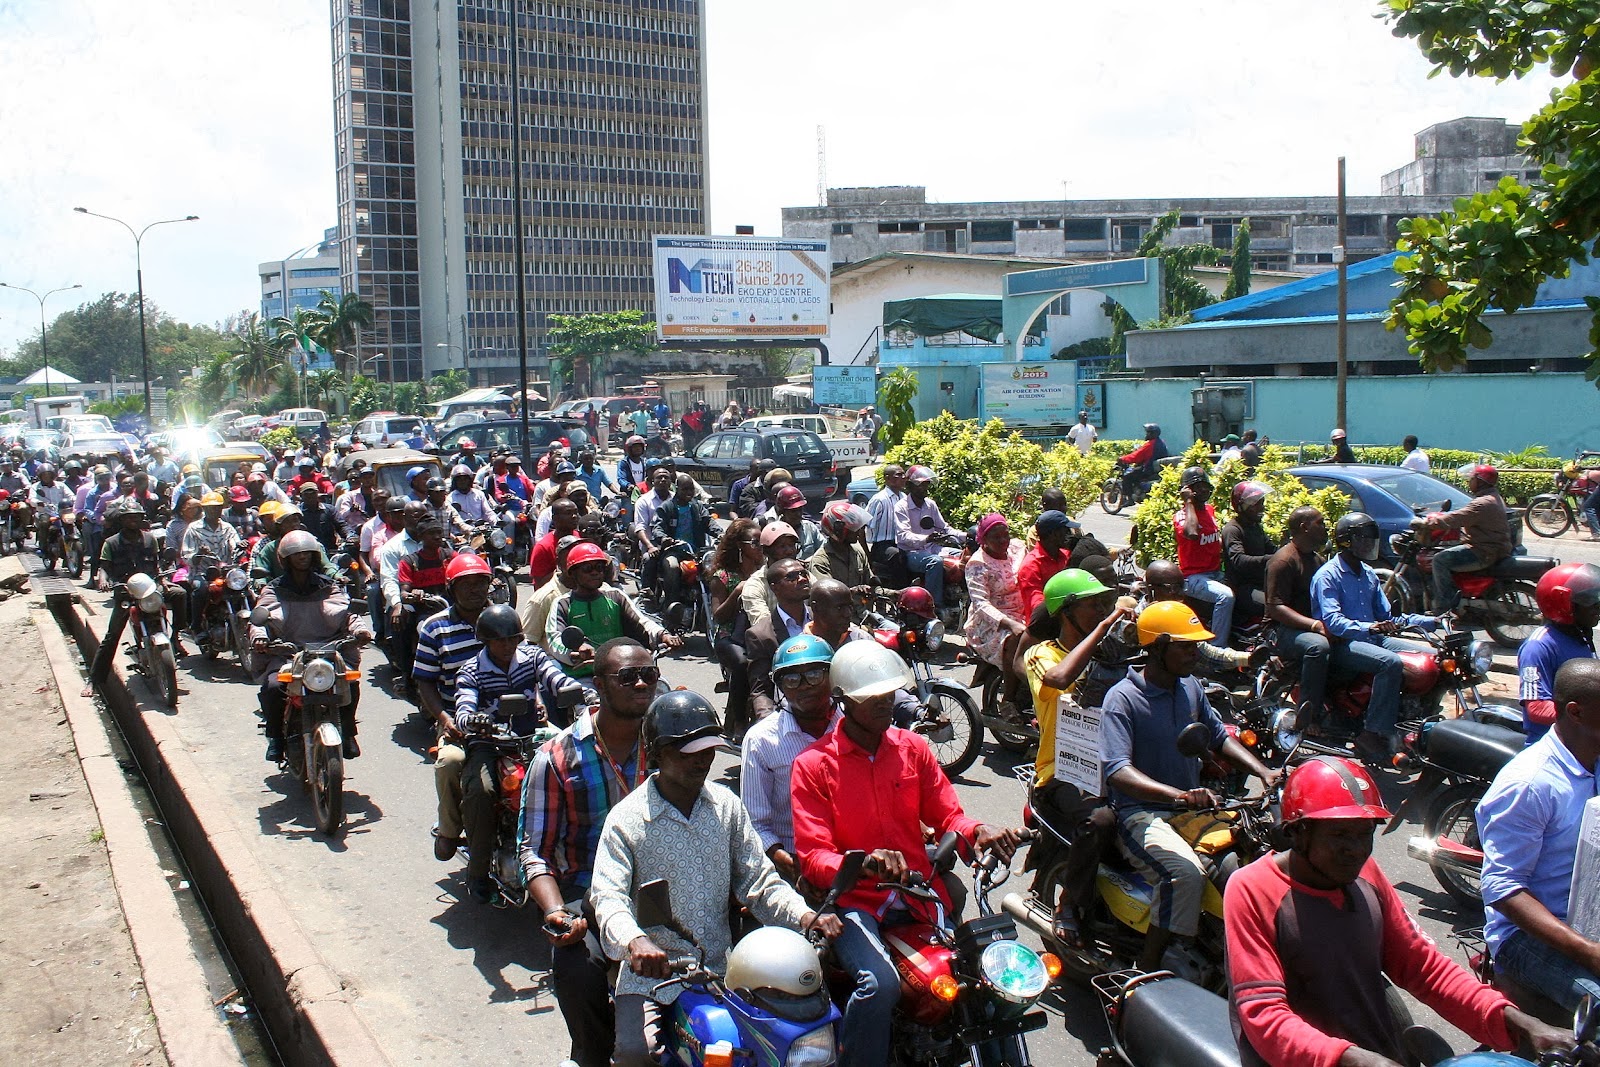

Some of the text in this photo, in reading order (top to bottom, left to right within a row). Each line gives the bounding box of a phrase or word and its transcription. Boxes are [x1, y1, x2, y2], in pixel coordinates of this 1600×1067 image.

[735, 259, 773, 273] 26-28
[702, 271, 734, 295] TECH
[735, 273, 805, 286] June 2012
[738, 288, 812, 296] EKO EXPO CENTRE
[670, 295, 735, 304] Technology Exhibition
[738, 296, 770, 304] VICTORIA
[799, 296, 821, 304] LAGOS
[699, 326, 734, 334] registration:
[829, 447, 862, 457] OYOTA
[1200, 532, 1221, 546] bwi
[1061, 709, 1082, 721] ABRO
[1059, 751, 1080, 763] ABRO
